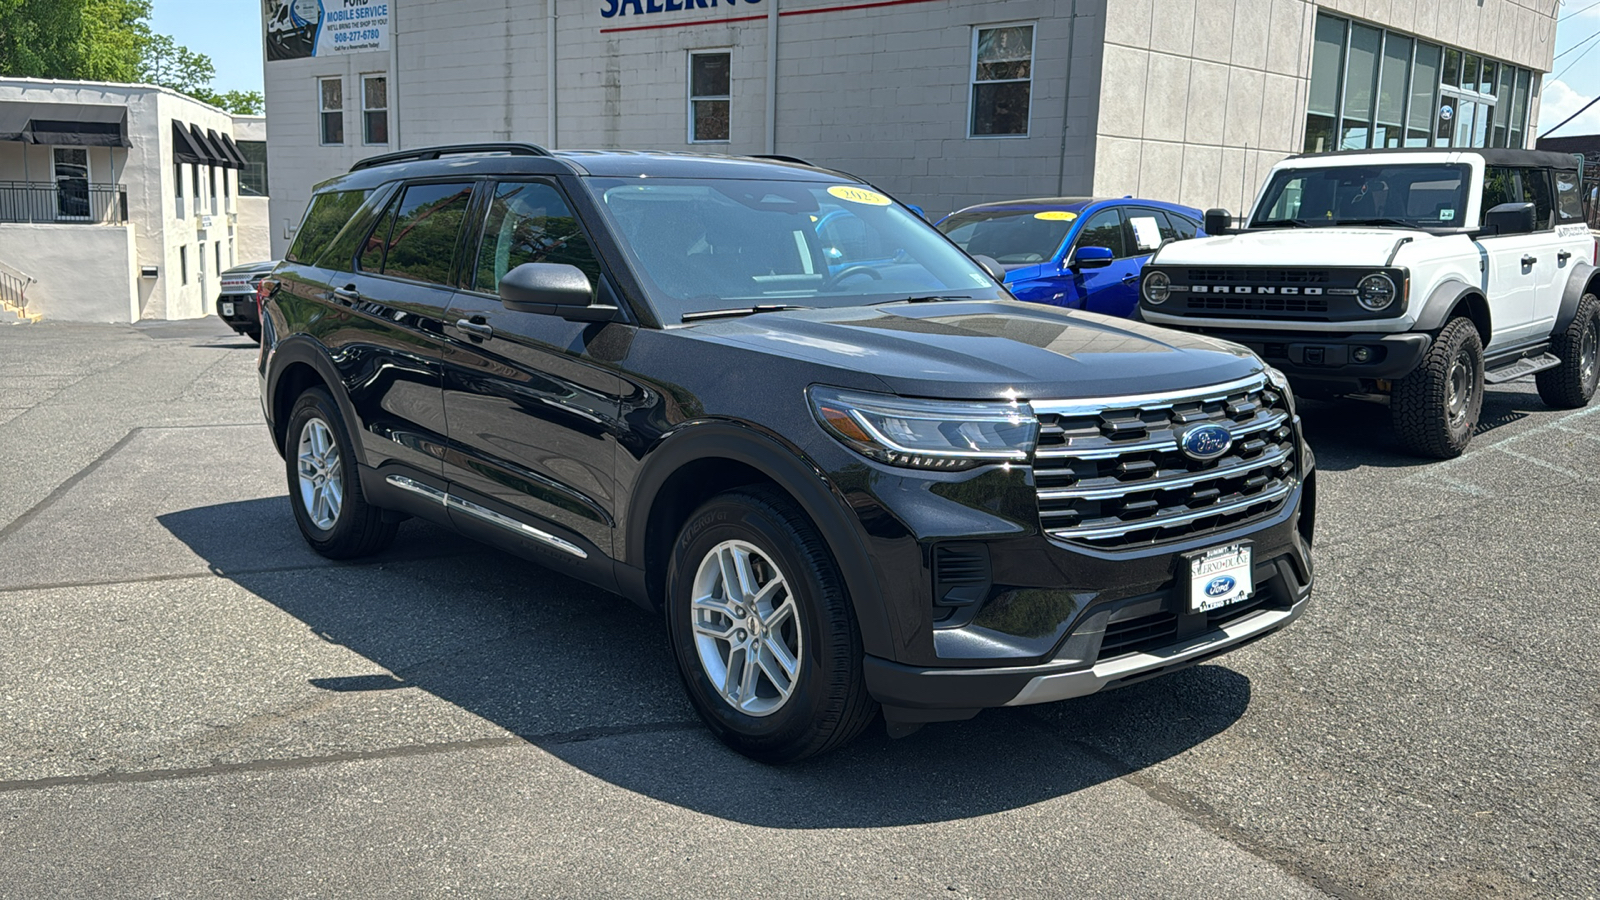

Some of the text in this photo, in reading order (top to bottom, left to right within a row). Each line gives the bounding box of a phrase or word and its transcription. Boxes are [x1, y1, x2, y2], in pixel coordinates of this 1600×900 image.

[326, 9, 354, 22] MOBILE
[355, 4, 388, 19] SERVICE
[339, 22, 351, 30] BRING
[359, 20, 371, 28] SHOP
[334, 29, 380, 43] 908-277-6780
[840, 188, 880, 202] 2025
[1192, 285, 1322, 295] BRONCO
[1197, 429, 1224, 452] Ford
[1209, 578, 1230, 595] Ford
